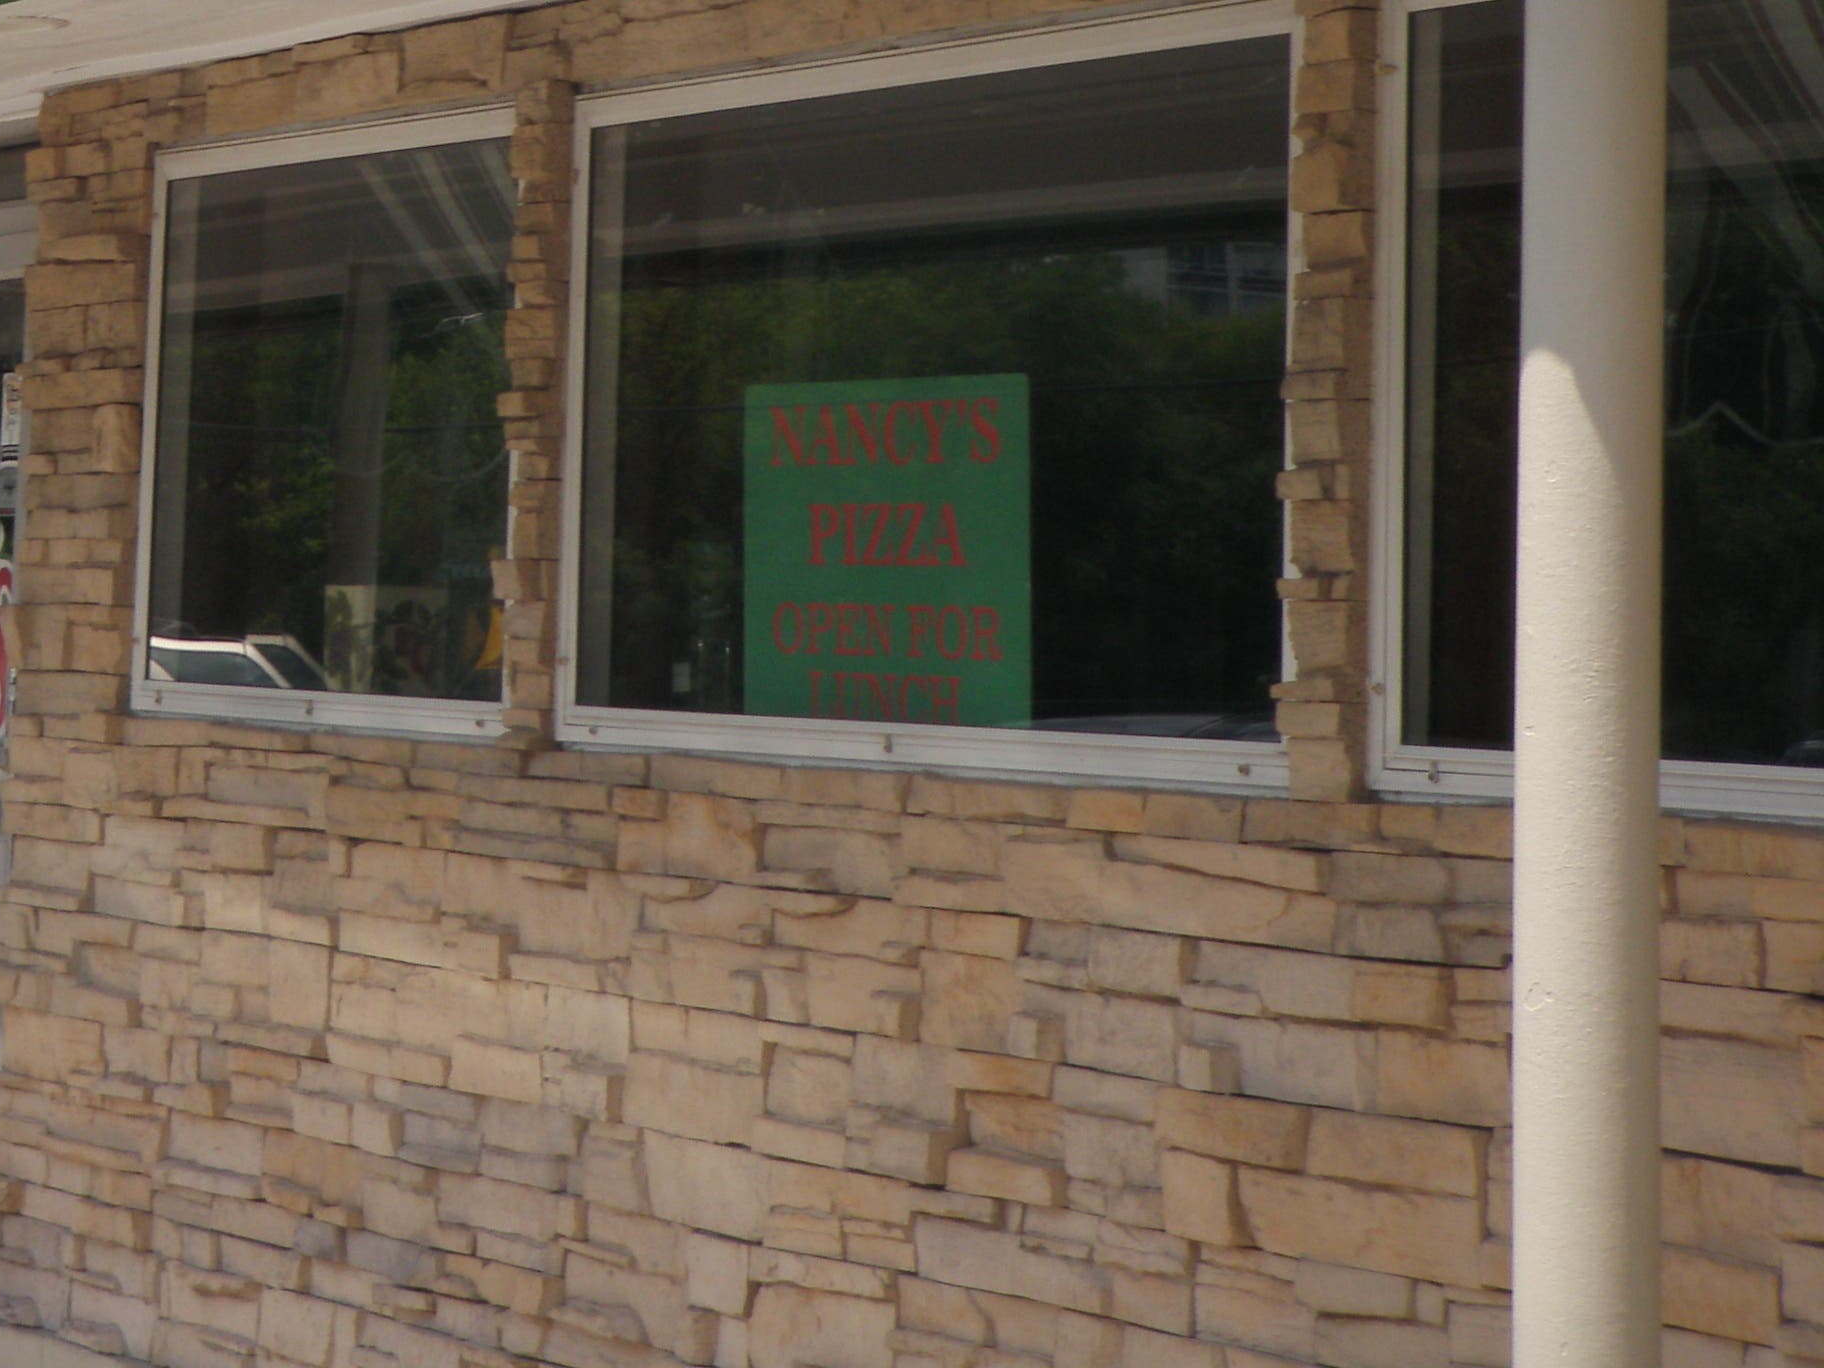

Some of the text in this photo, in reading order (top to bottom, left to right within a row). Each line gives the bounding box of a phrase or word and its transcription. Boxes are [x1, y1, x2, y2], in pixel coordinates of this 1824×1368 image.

[770, 397, 1001, 466] NANCY'S
[808, 503, 967, 566] PIZZA
[773, 601, 1003, 661] OPEN FOR
[809, 670, 961, 725] LUNCH
